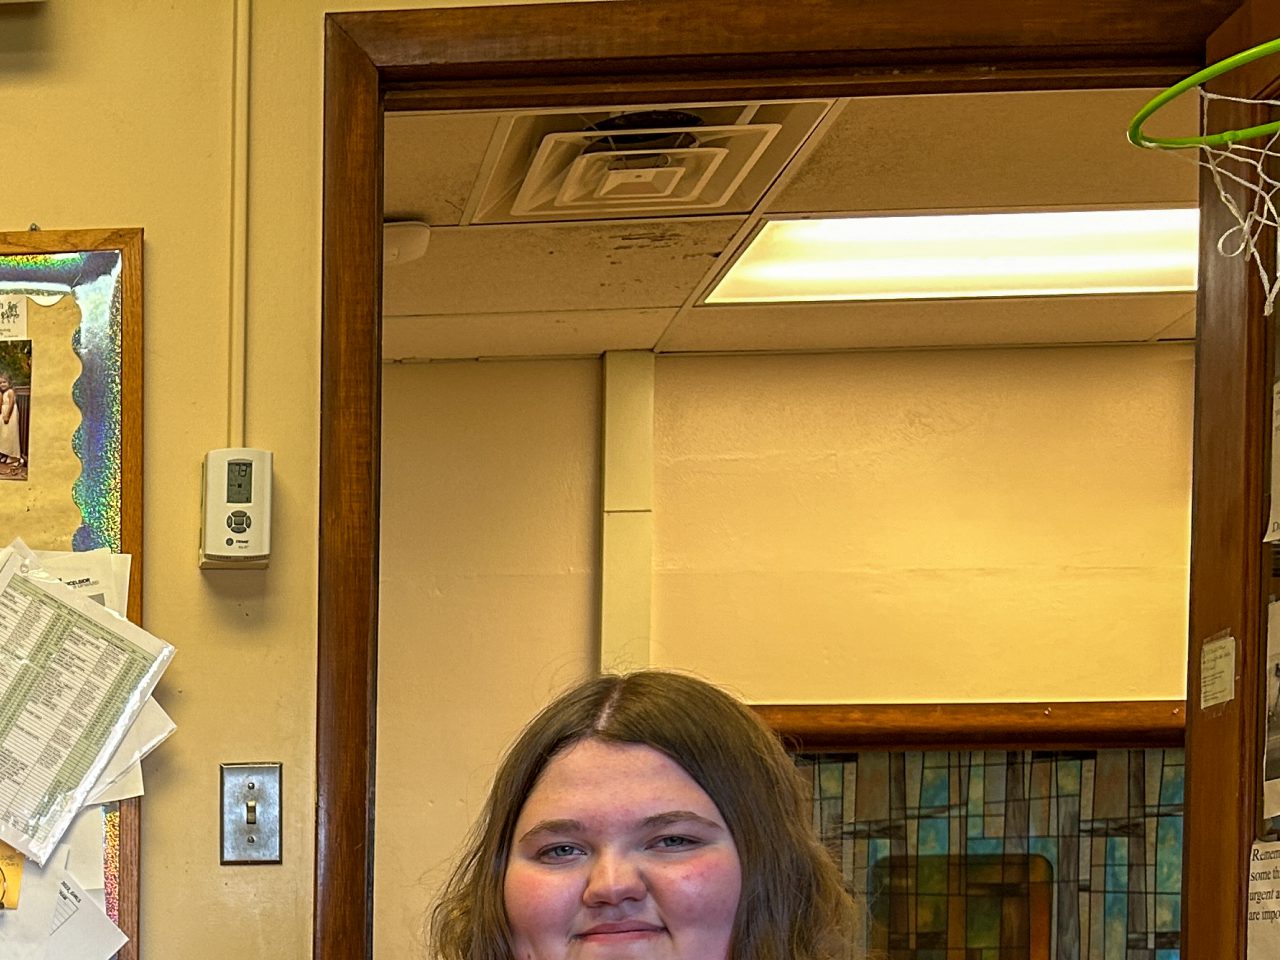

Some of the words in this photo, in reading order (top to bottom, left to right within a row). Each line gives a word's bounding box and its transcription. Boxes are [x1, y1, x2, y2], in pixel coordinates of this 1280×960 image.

[1250, 870, 1271, 882] some
[1250, 888, 1273, 904] urgent
[1249, 912, 1260, 921] are
